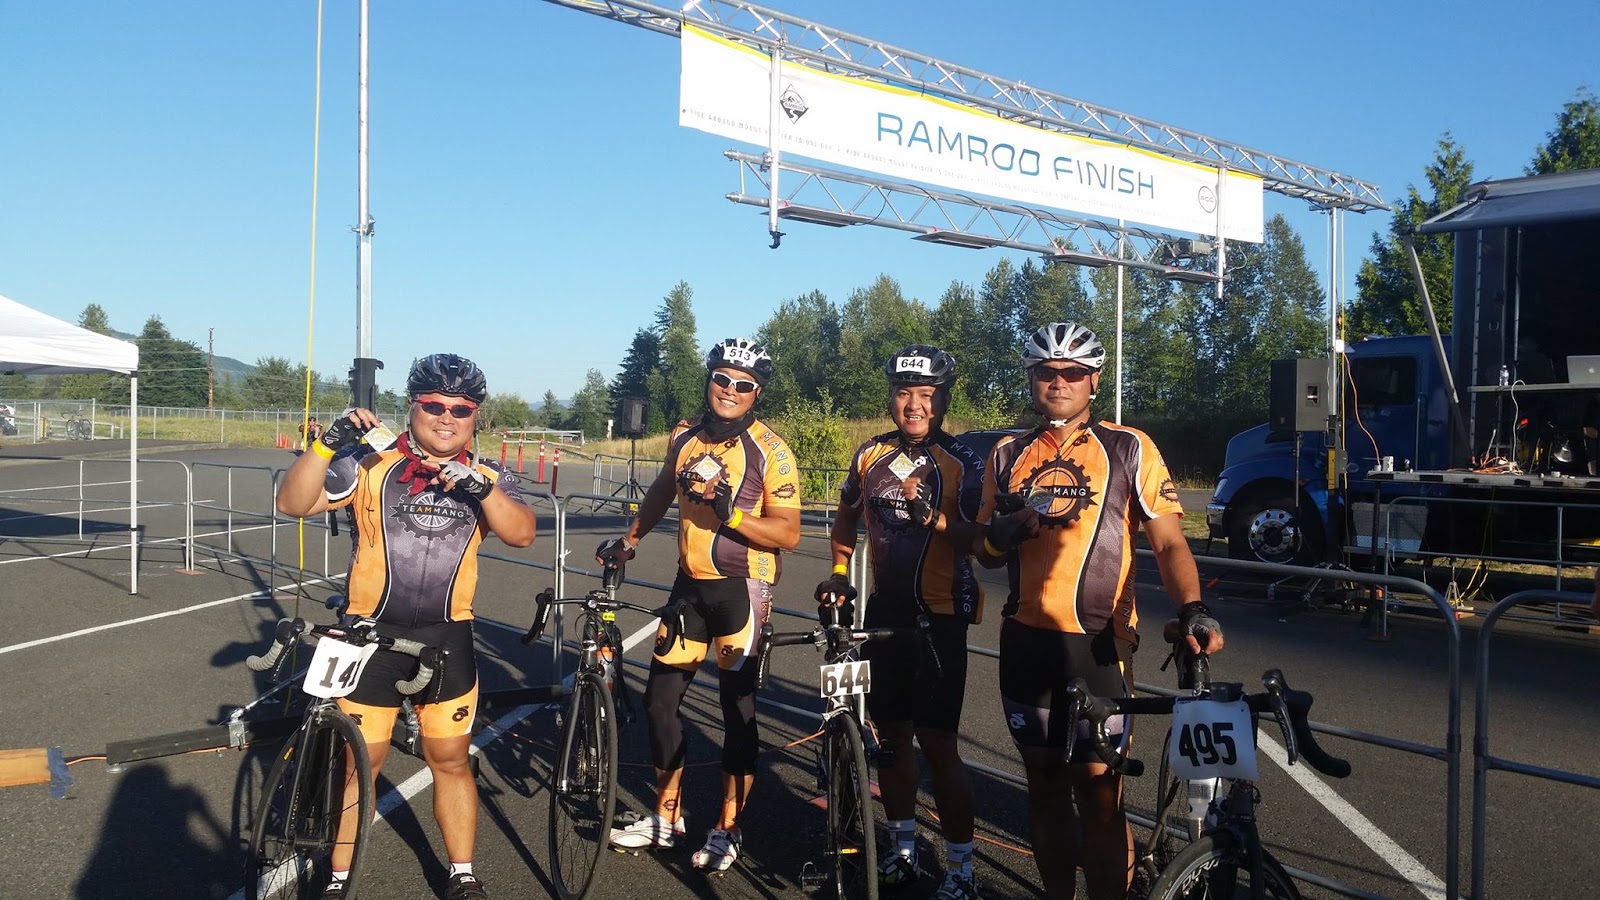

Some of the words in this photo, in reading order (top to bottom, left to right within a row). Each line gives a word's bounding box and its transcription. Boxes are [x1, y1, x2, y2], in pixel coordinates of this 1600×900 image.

[877, 111, 1041, 176] RAMROD
[1053, 156, 1155, 199] FINISH
[729, 348, 751, 361] 513
[901, 358, 924, 369] 644
[822, 662, 870, 697] 644
[1178, 722, 1238, 767] 495
